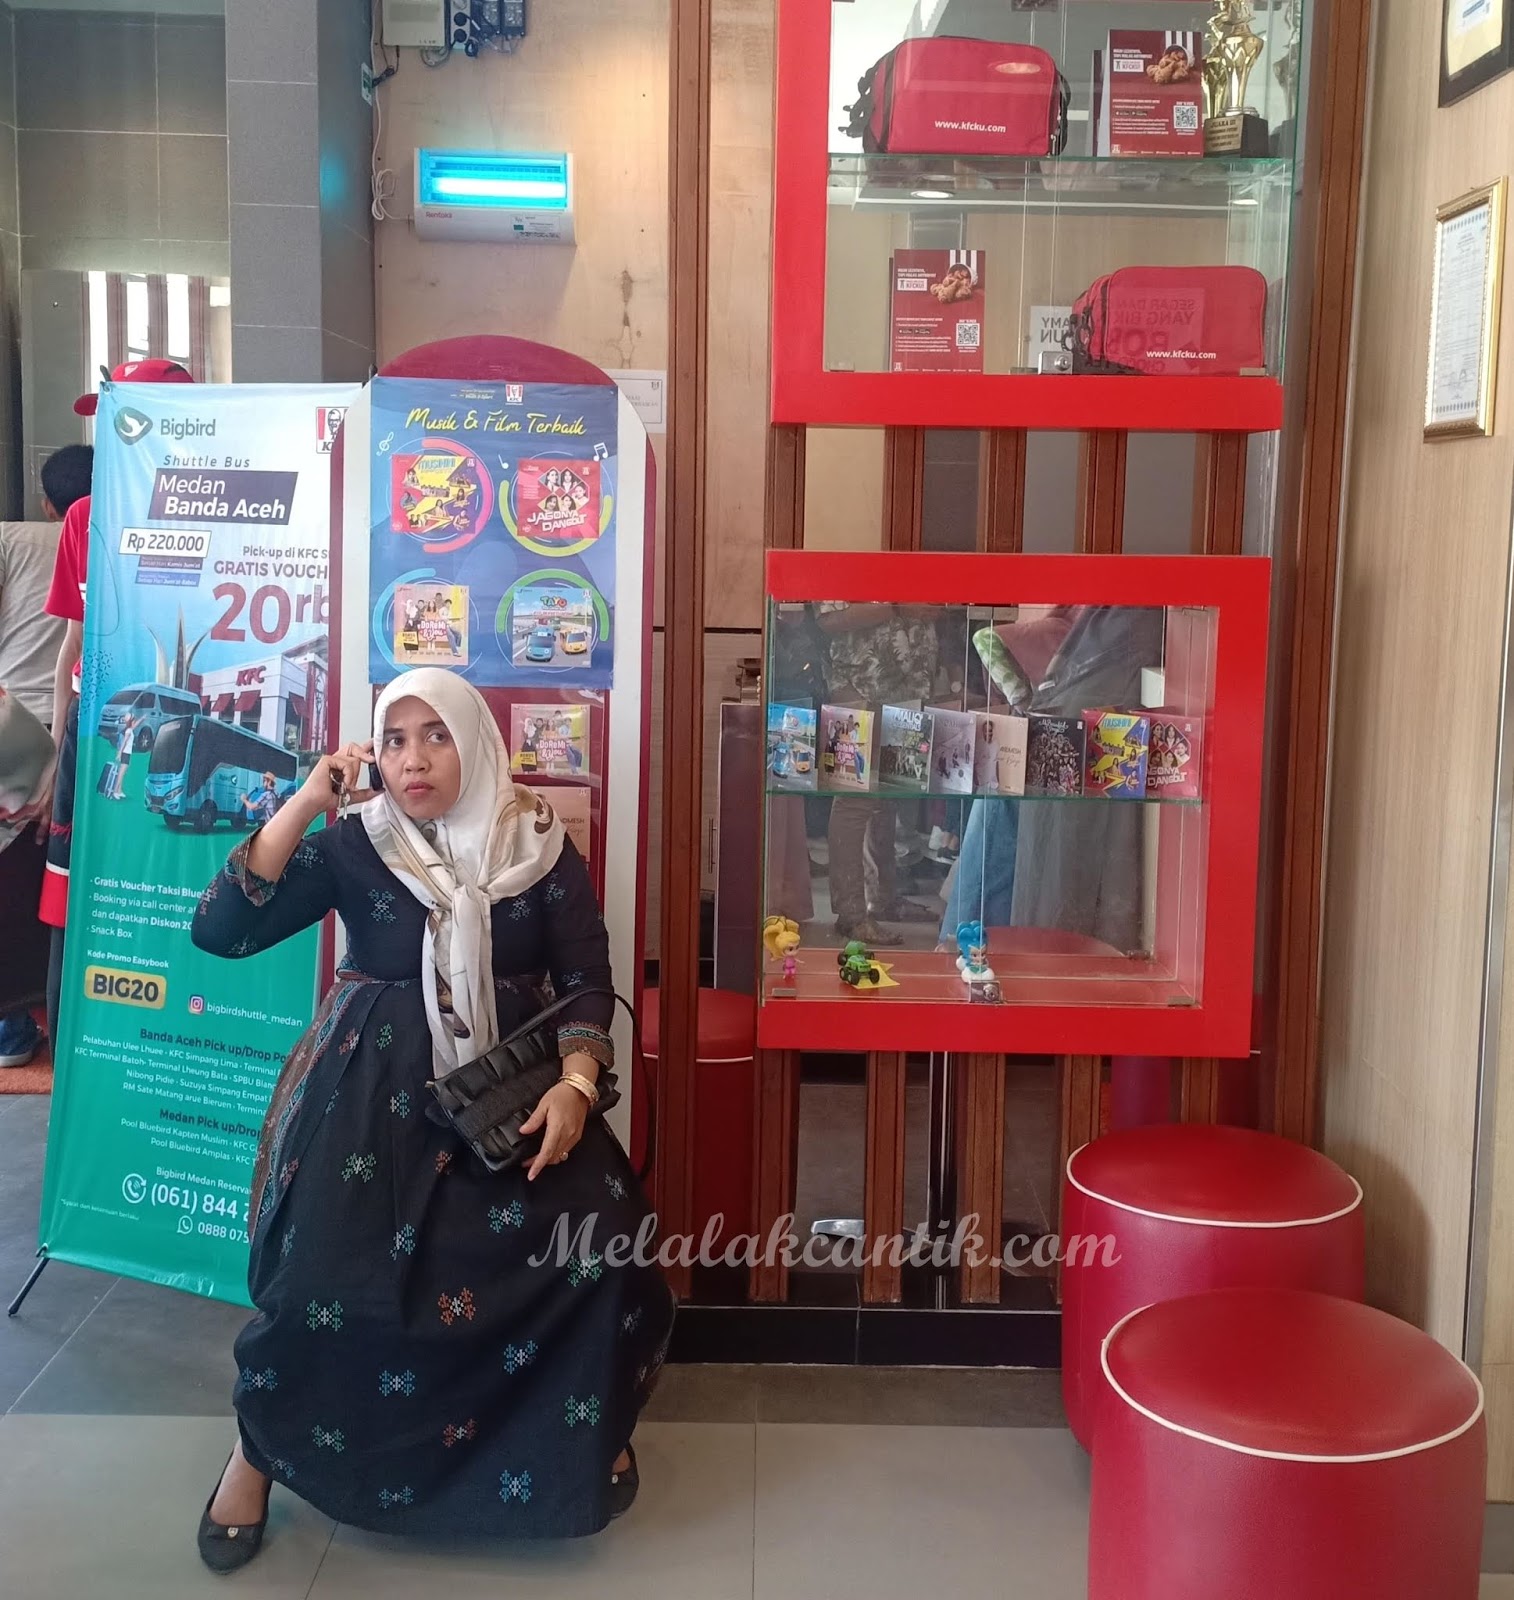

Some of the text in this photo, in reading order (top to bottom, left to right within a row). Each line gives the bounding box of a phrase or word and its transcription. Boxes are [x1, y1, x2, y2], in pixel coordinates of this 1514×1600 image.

[934, 119, 1006, 134] www.kfcku.com
[1146, 350, 1217, 360] www.kfcku.com
[160, 418, 216, 440] Bigbird
[405, 408, 587, 435] Musik & Film Terbaik
[163, 455, 250, 468] Shuttle Bus
[158, 475, 226, 495] Medan
[164, 496, 286, 519] Banda Aceh
[527, 511, 578, 526] JAGONYA
[127, 533, 204, 552] Rp 220.000
[243, 545, 283, 560] Pick-up
[285, 547, 295, 558] di
[297, 548, 319, 559] KFC
[214, 560, 269, 576] GRATIS
[540, 596, 567, 608] TAYO
[236, 665, 267, 687] KFC
[94, 877, 119, 888] Gratis
[120, 879, 156, 892] Voucher
[157, 884, 180, 895] Taksi
[93, 893, 127, 907] Booking
[128, 898, 141, 907] via
[142, 899, 157, 909] call
[158, 902, 186, 913] center
[91, 909, 107, 918] dan
[108, 910, 149, 925] dapatkan
[150, 917, 180, 929] Diskon
[91, 925, 133, 938] Snack Box
[87, 949, 169, 968] Kode Promo Easybook
[93, 973, 159, 1003] BIG20
[207, 1002, 303, 1027] bigbirdshuttle_medan
[82, 1034, 121, 1048] Pelabuhan
[169, 1049, 185, 1060] KFC
[185, 1052, 219, 1067] Simpang
[220, 1059, 238, 1068] Lima
[244, 1062, 276, 1076] Terminal
[140, 1028, 173, 1043] Banda
[175, 1034, 201, 1048] Aceh
[204, 1038, 226, 1052] Pick
[228, 1045, 271, 1062] up/Drop
[74, 1046, 88, 1056] KFC
[89, 1049, 120, 1062] Terminal
[148, 1059, 180, 1072] Terminal
[182, 1065, 210, 1078] Lheung
[211, 1070, 228, 1080] Bata
[233, 1075, 254, 1086] SPBU
[123, 1082, 135, 1091] RM
[137, 1085, 153, 1094] Sate
[155, 1088, 183, 1101] Matang
[126, 1069, 267, 1103] Nibong Pidie Suzuya Simpang Empat
[160, 1108, 195, 1125] Medan
[197, 1115, 219, 1130] Pick
[121, 1118, 138, 1128] Pool
[139, 1121, 172, 1134] Bluebird
[172, 1128, 200, 1141] Kapten
[201, 1133, 228, 1146] Muslim
[233, 1140, 248, 1151] KFC
[151, 1137, 168, 1147] Pool
[169, 1140, 201, 1154] Bluebird
[202, 1148, 230, 1160] Amplas
[235, 1155, 251, 1165] KFC
[156, 1166, 186, 1179] Bigbird
[187, 1173, 216, 1187] Medan
[151, 1183, 198, 1215] (061)
[202, 1194, 238, 1219] 844
[198, 1222, 227, 1238] 0888
